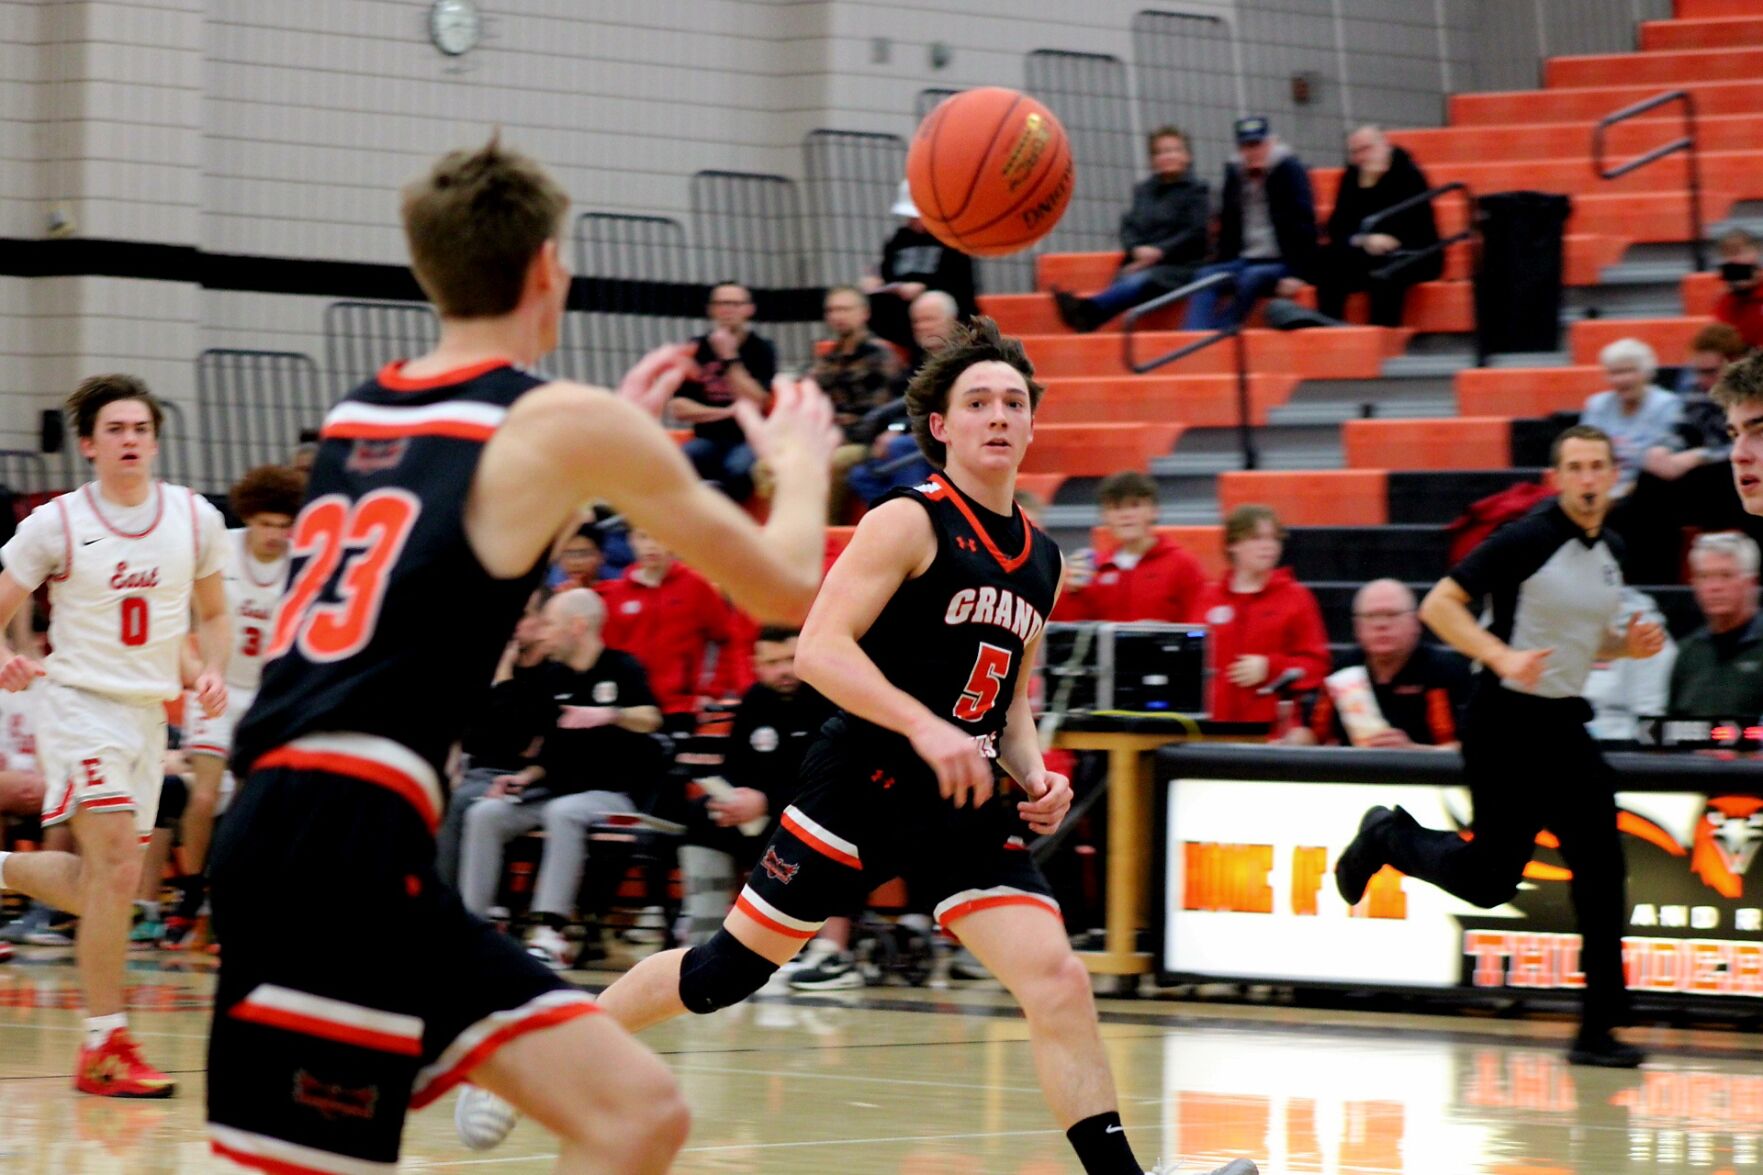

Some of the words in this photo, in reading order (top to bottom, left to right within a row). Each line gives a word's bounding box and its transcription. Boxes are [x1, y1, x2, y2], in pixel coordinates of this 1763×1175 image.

[109, 561, 161, 590] East
[264, 487, 422, 663] 23
[121, 597, 148, 646] 0
[944, 586, 1044, 646] GRAND
[952, 641, 1012, 723] 5
[81, 757, 105, 787] E
